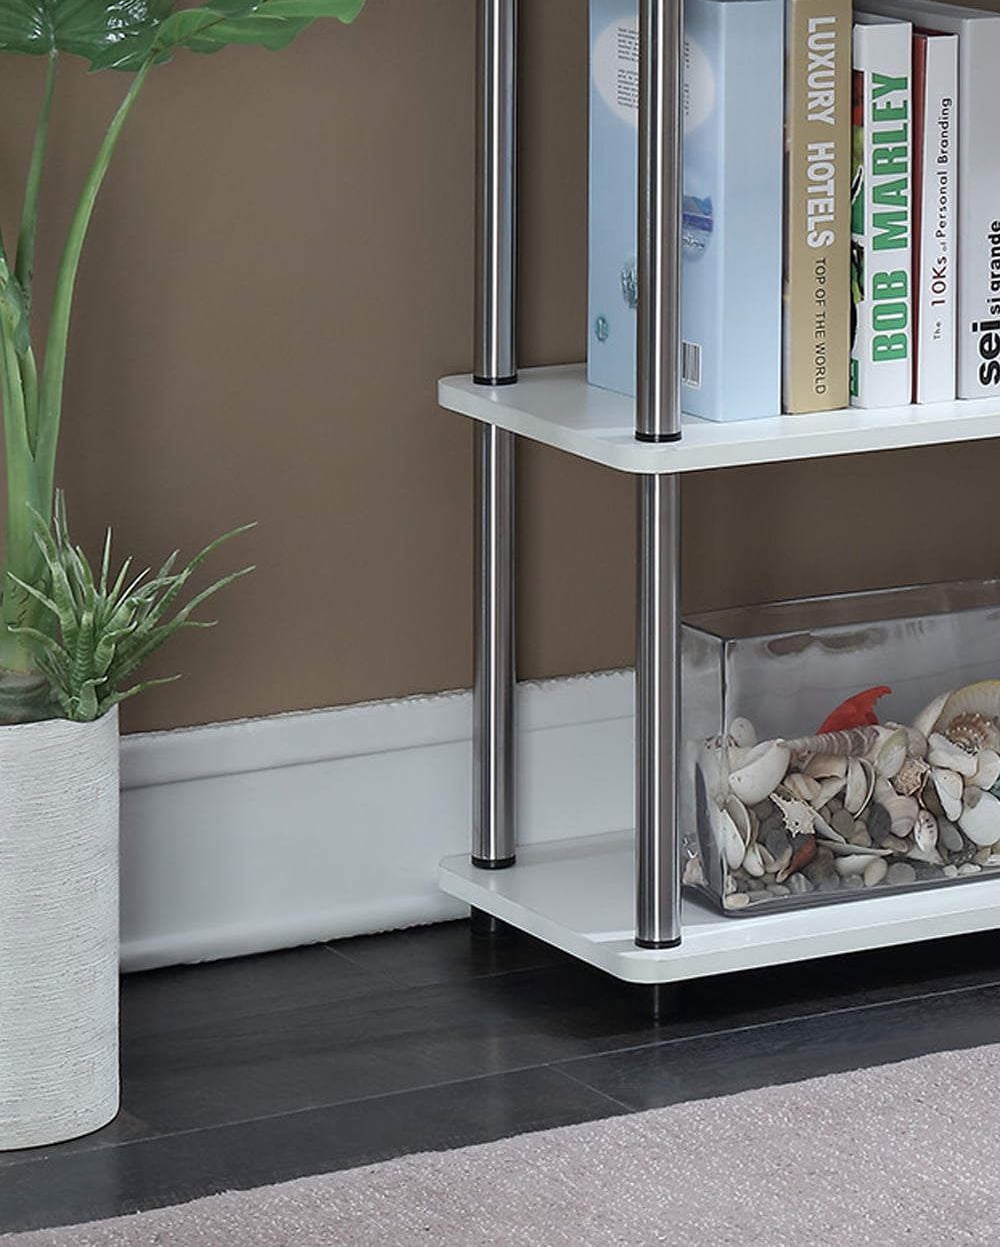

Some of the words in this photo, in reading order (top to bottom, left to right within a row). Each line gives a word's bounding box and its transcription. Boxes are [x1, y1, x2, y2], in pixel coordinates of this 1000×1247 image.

[806, 16, 836, 126] LUXURY
[872, 72, 909, 251] MARLEY
[937, 97, 952, 164] Branding
[806, 142, 836, 249] HOTELS
[935, 170, 948, 238] Personal
[815, 257, 827, 284] TOP
[815, 288, 827, 307] OF
[931, 256, 947, 307] 10Ks
[815, 311, 826, 338] THE
[872, 269, 908, 362] BOB
[933, 321, 942, 340] The
[972, 319, 1000, 386] sei
[990, 293, 1000, 315] si
[814, 342, 826, 394] WORLD
